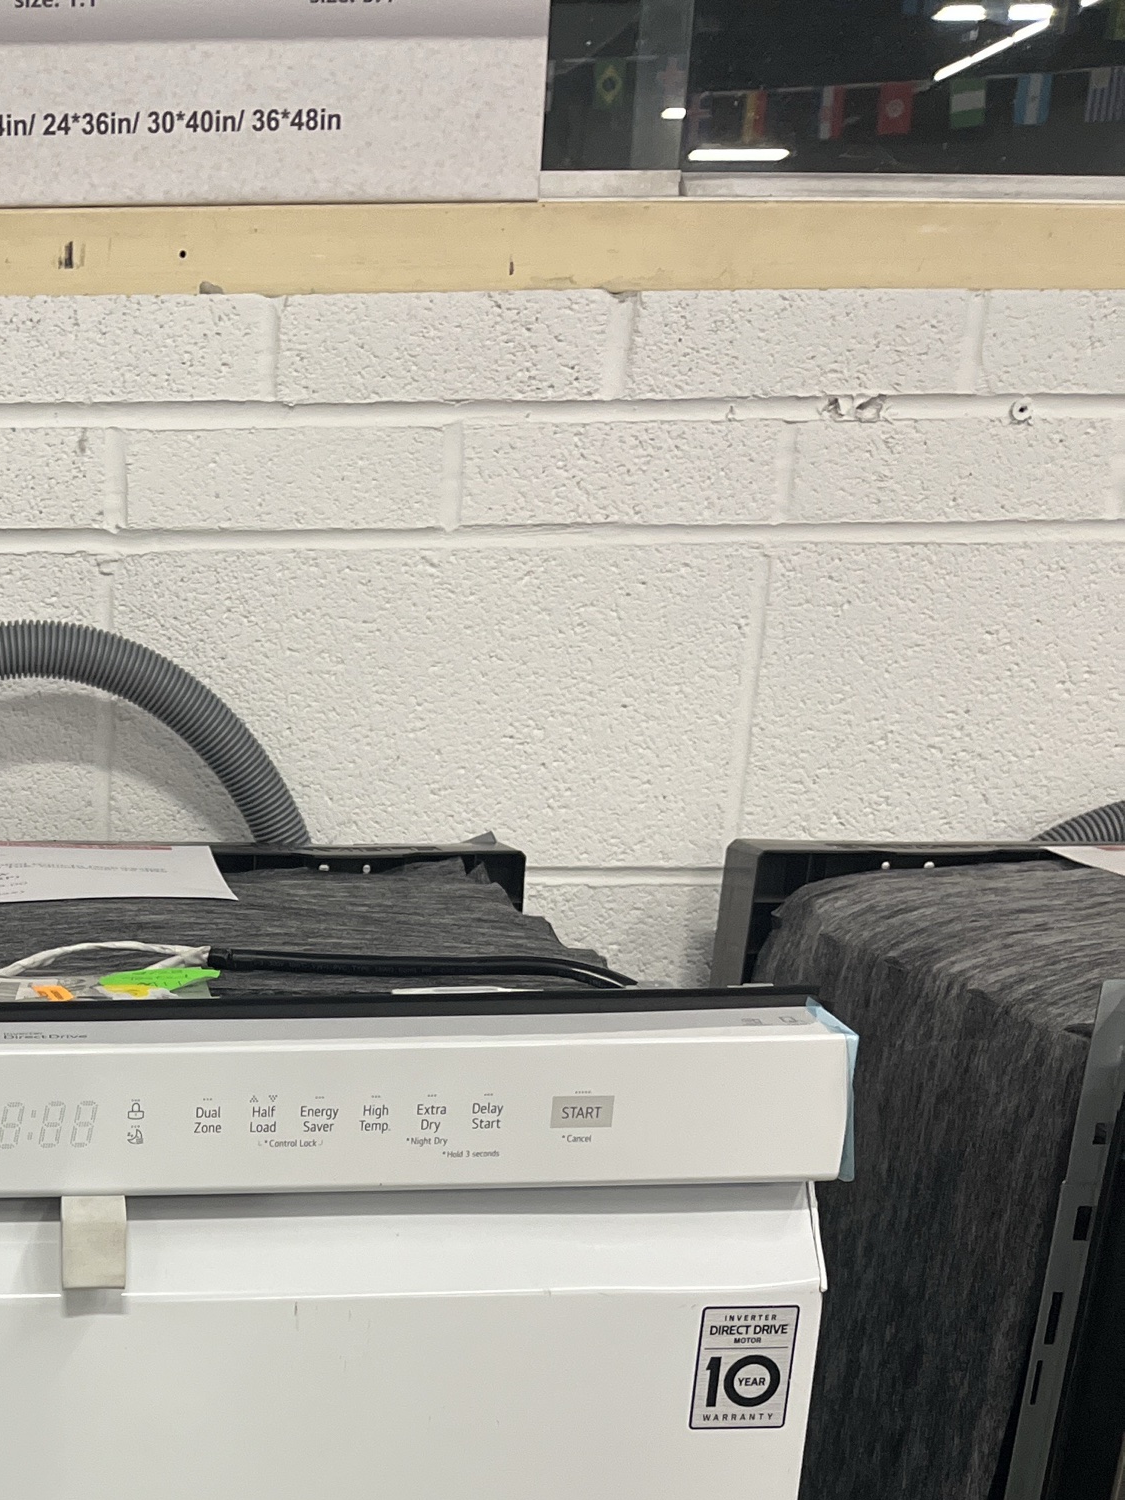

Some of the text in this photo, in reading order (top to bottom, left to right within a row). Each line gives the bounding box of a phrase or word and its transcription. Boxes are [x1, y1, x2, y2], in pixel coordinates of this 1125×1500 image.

[195, 1106, 222, 1119] Dual
[251, 1105, 277, 1118] Half
[299, 1105, 340, 1120] Energy
[362, 1104, 390, 1119] High
[416, 1103, 448, 1116] Extra
[471, 1102, 504, 1116] Delay
[561, 1106, 602, 1120] START
[193, 1121, 222, 1134] Zone
[249, 1120, 277, 1133] Load
[302, 1120, 335, 1133] Saver
[359, 1119, 392, 1134] Temp.
[420, 1118, 441, 1133] Dry
[471, 1117, 502, 1130] Start
[299, 1139, 317, 1148] Lock
[433, 1136, 449, 1147] Dry
[465, 1150, 471, 1158] 3
[472, 1150, 501, 1158] seconds
[724, 1314, 778, 1322] INVERTER
[709, 1323, 789, 1336] DIRECT DRIVE
[733, 1336, 762, 1344] MOTOR
[705, 1354, 781, 1408] 10
[737, 1376, 766, 1387] YEAR
[702, 1412, 775, 1422] WARRANTY
